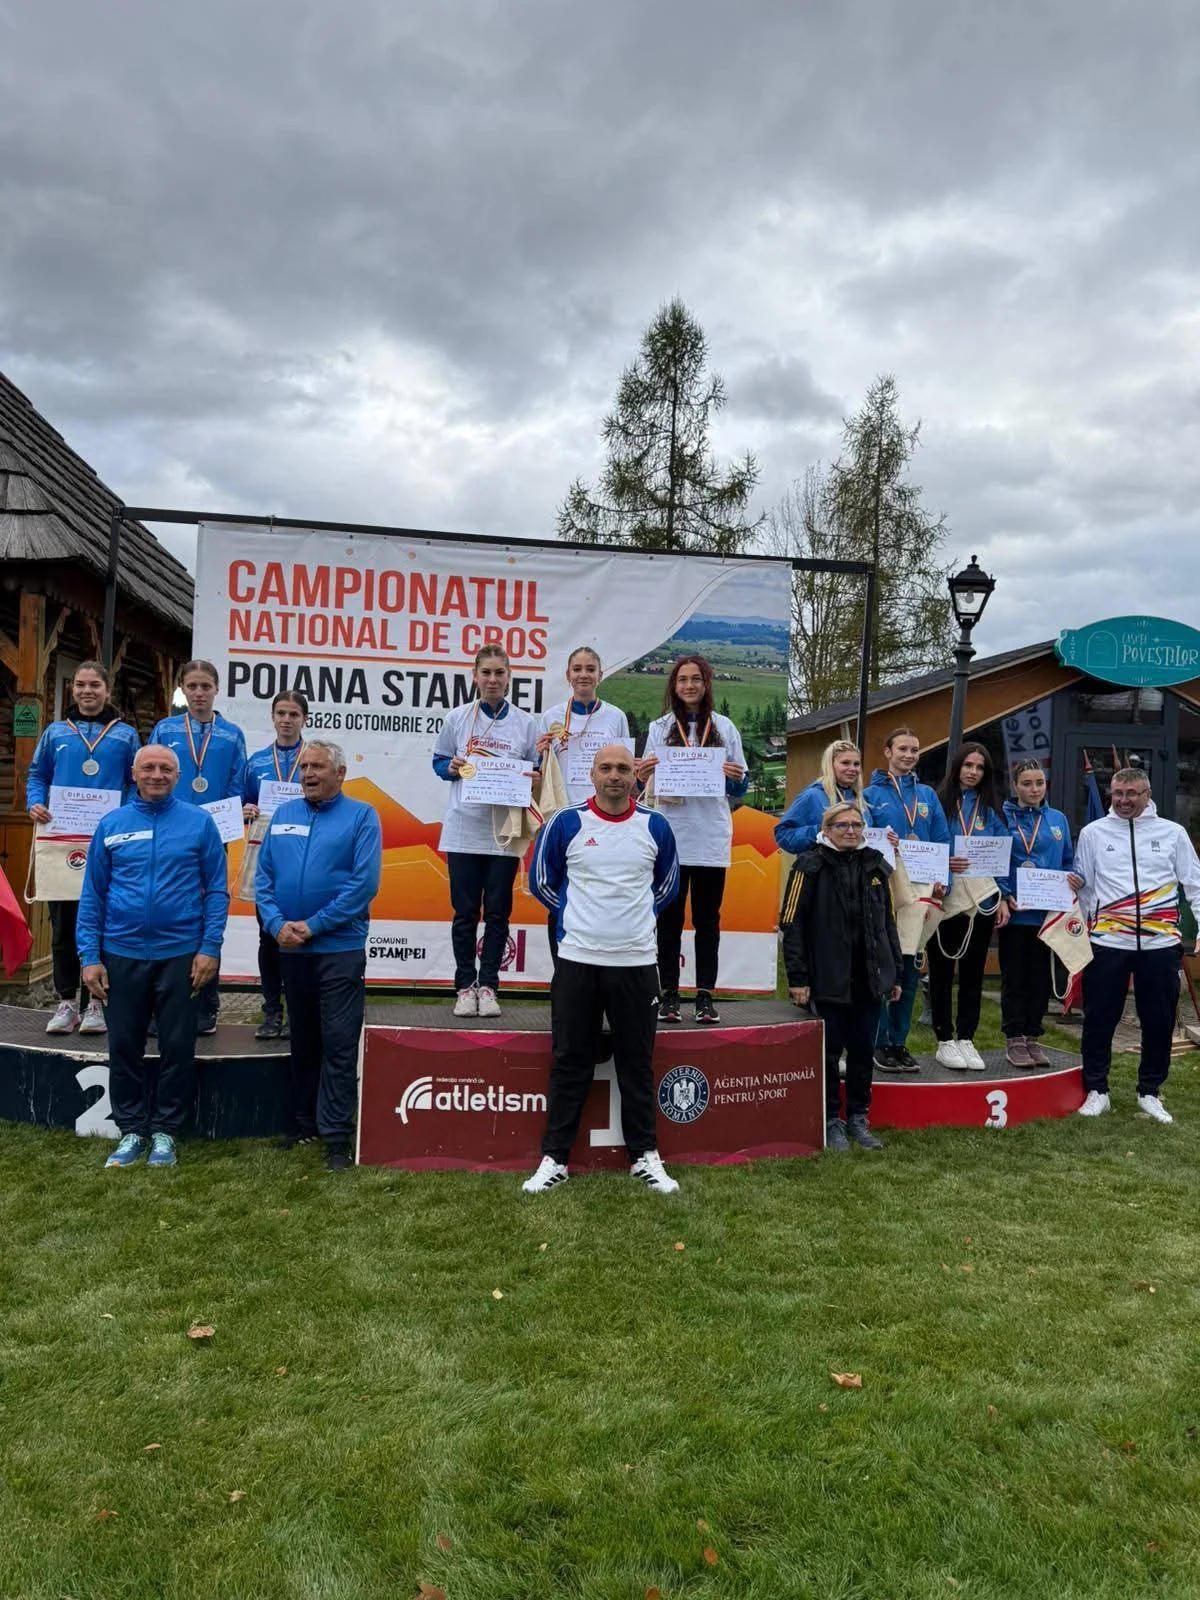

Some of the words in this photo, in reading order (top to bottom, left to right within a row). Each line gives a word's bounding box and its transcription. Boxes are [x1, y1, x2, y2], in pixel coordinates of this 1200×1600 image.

[229, 559, 549, 623] CAMPIONATUL
[229, 608, 398, 651] NATIONAL
[408, 620, 451, 654] DE
[461, 624, 548, 660] CROS
[227, 661, 370, 705] POIANA
[381, 669, 544, 714] STAMEI
[305, 712, 342, 730] 5&26
[345, 713, 423, 733] OCTOMBRIE
[426, 717, 445, 735] 20
[481, 761, 517, 769] DIPLOMA
[67, 791, 104, 801] DIPLOMA
[904, 844, 935, 852] DIPLOMA
[369, 936, 408, 945] COMUNEI
[368, 947, 426, 962] STAMPEI
[662, 1067, 706, 1089] GUVERNUL
[75, 1065, 122, 1139] 2
[435, 1085, 548, 1112] atletism
[714, 1091, 756, 1105] PENTRU
[758, 1087, 788, 1101] SPORT
[985, 1089, 1008, 1128] 3
